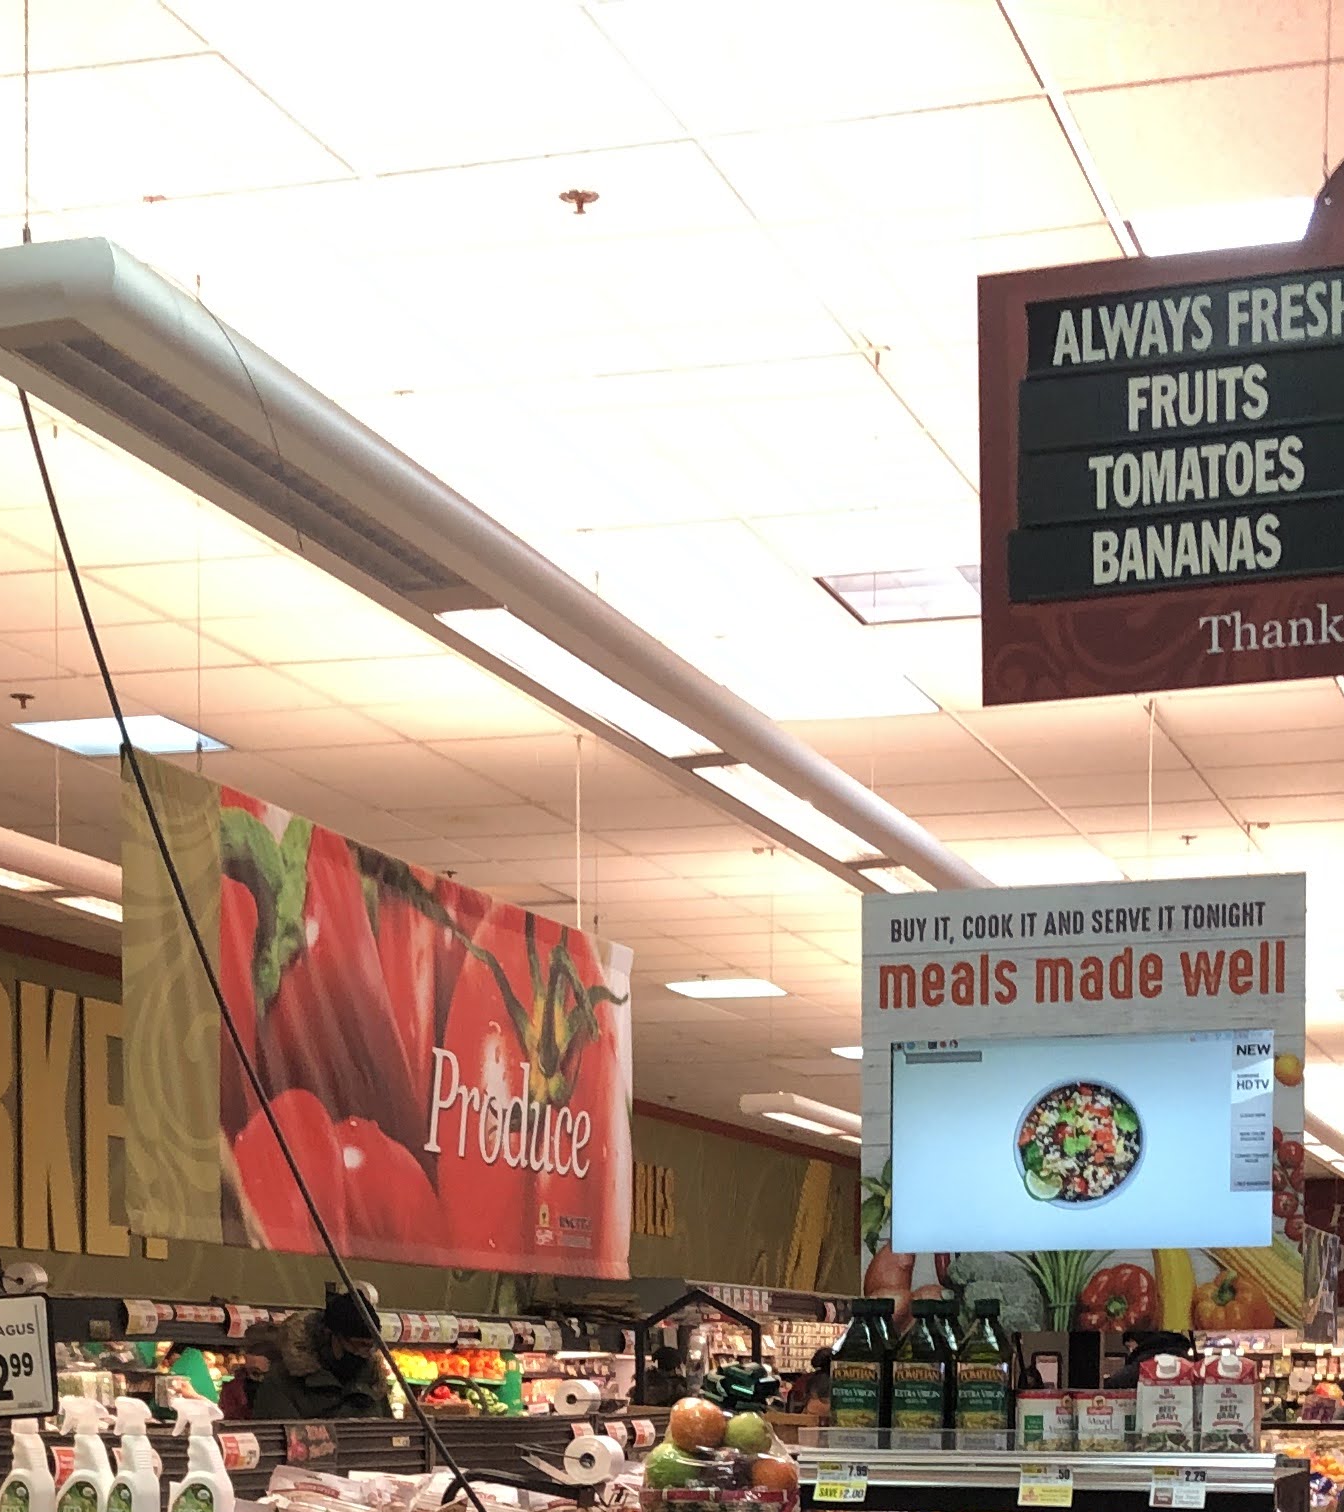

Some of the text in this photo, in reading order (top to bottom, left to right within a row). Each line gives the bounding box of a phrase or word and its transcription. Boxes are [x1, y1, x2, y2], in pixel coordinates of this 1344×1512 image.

[1053, 295, 1212, 366] ALWAYS
[1128, 363, 1269, 432] FRUITS
[1089, 435, 1305, 510] TOMATOES
[1093, 513, 1282, 585] BANANAS
[891, 901, 1266, 944] BUY IT, COOK IT AND SERVE IT TONIGHT
[879, 939, 1286, 1010] meals made well
[1236, 1043, 1272, 1056] NEW
[424, 1047, 592, 1179] Produce
[819, 1487, 838, 1497] SAVE
